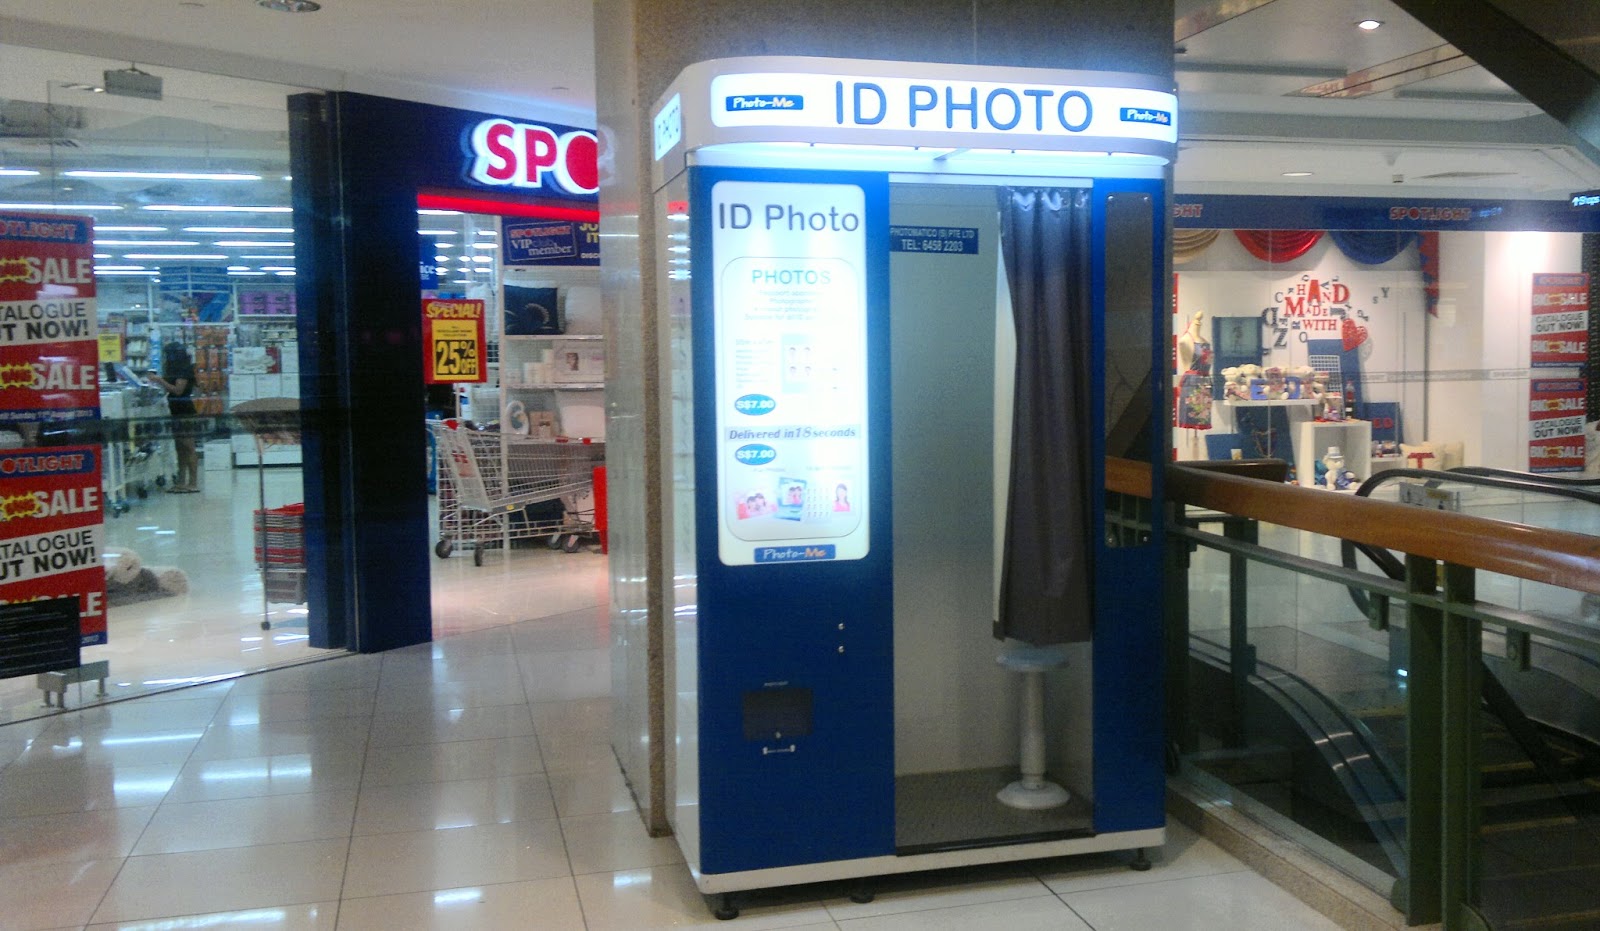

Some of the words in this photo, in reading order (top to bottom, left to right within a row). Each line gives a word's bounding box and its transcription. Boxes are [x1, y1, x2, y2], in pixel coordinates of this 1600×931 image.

[733, 97, 795, 108] Photo-Me
[836, 80, 887, 124] ID
[909, 85, 1093, 132] PHOTO
[471, 119, 599, 194] SPO
[719, 202, 752, 229] ID
[765, 204, 859, 231] Photo
[1389, 206, 1471, 220] SPOTLIGHT
[962, 230, 975, 239] LTD
[511, 239, 532, 249] VIP
[528, 242, 572, 256] member
[26, 256, 92, 284] SALE
[751, 269, 831, 285] PHOTOS
[1560, 292, 1587, 306] SALE
[426, 301, 482, 318] SPECIAL!
[1536, 312, 1583, 323] CATALOGUE
[26, 320, 89, 340] NOW!
[1302, 319, 1337, 331] WITH
[1536, 323, 1555, 332] OUT
[1559, 341, 1586, 353] SALE
[30, 362, 95, 390] SALE
[1558, 398, 1585, 410] SALE
[1534, 418, 1582, 429] CATALOGUE
[729, 429, 781, 440] Delivered
[784, 429, 795, 438] in
[796, 427, 812, 438] 18
[813, 428, 856, 437] seconds
[1534, 429, 1554, 438] OUT
[1558, 445, 1585, 458] SALE
[32, 486, 99, 518] SALE
[763, 547, 826, 559] Photo-Me
[34, 546, 96, 574] NOW!
